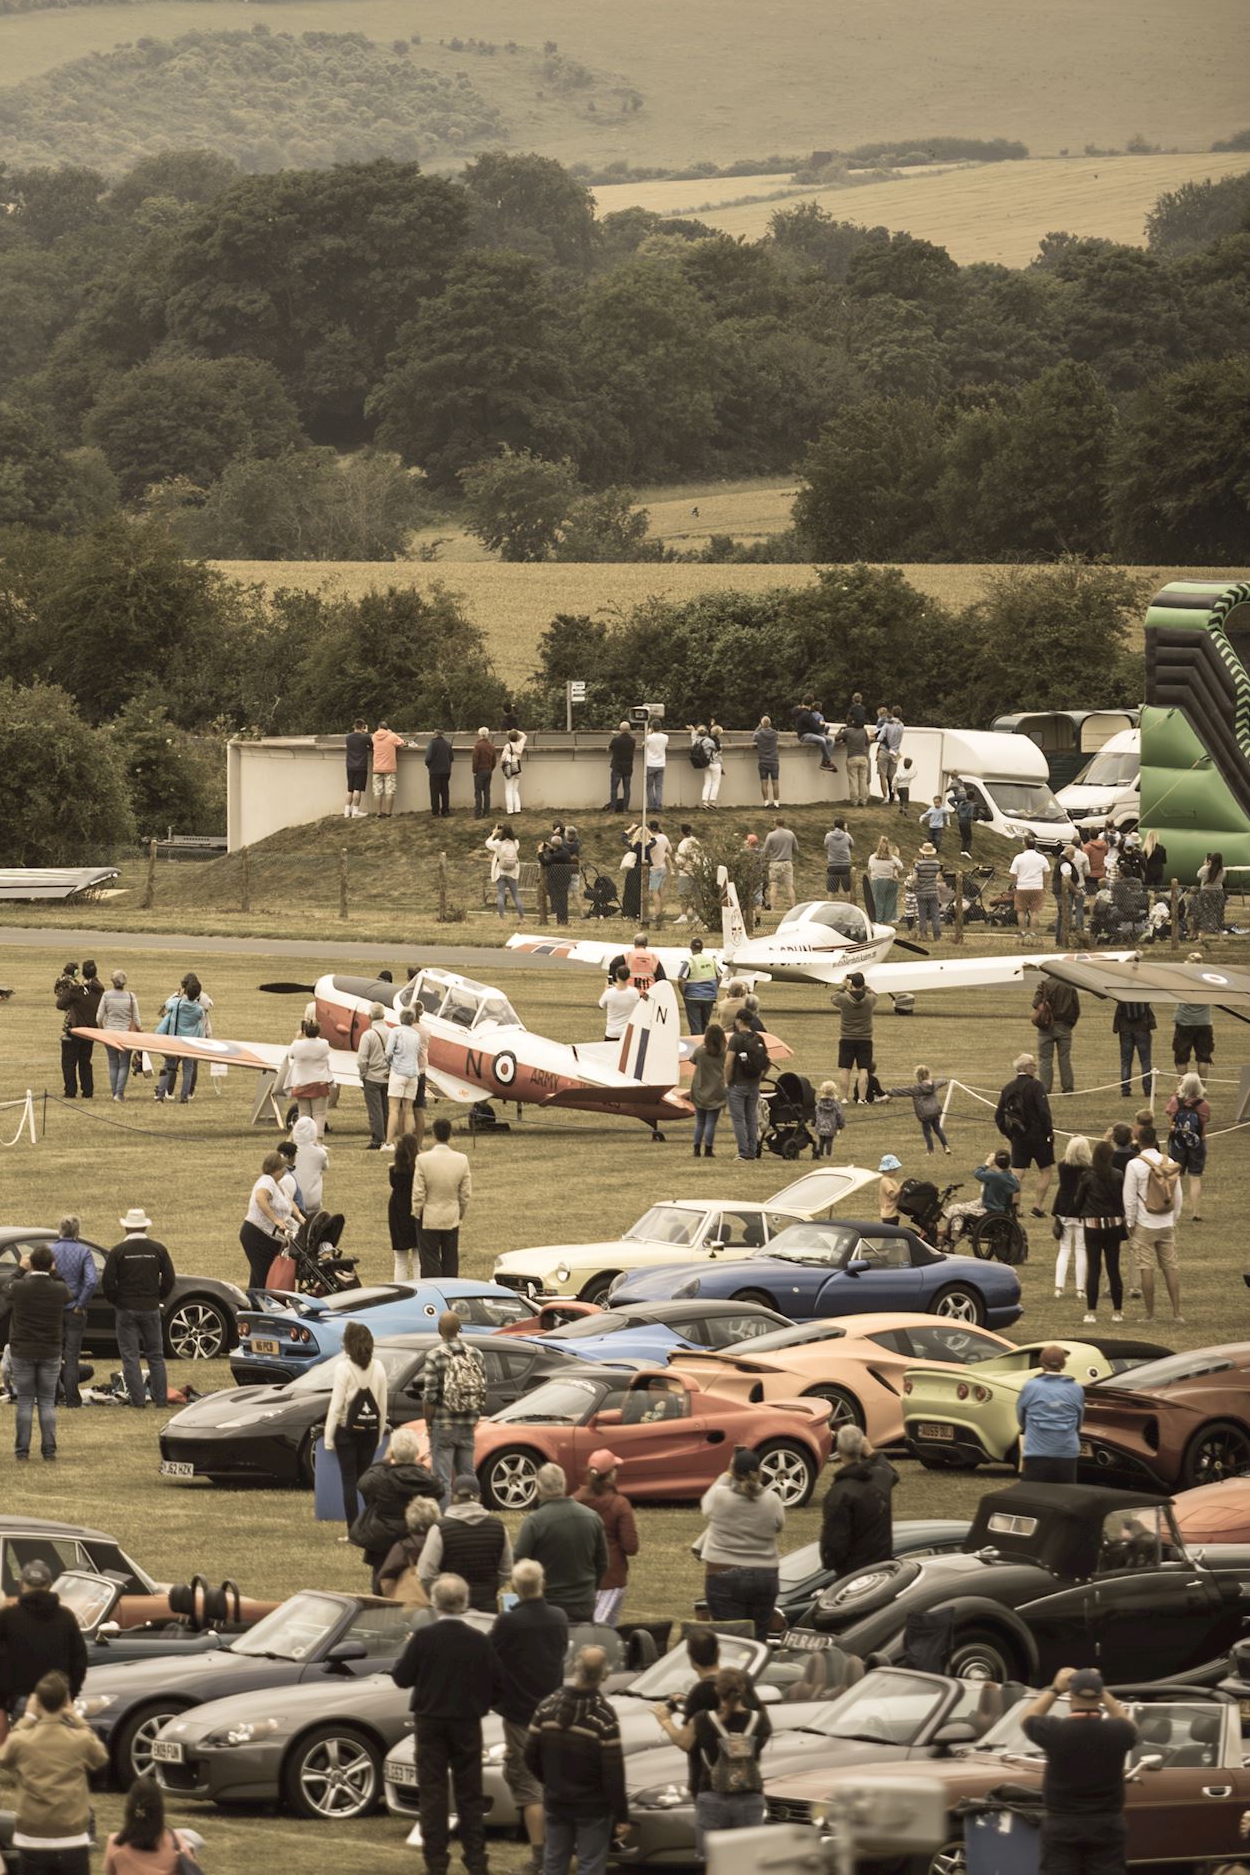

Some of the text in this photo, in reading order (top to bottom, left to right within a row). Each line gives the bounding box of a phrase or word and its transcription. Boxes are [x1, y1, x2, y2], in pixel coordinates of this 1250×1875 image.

[656, 1005, 668, 1025] N
[466, 1049, 483, 1079] N
[530, 1068, 560, 1089] ARMY
